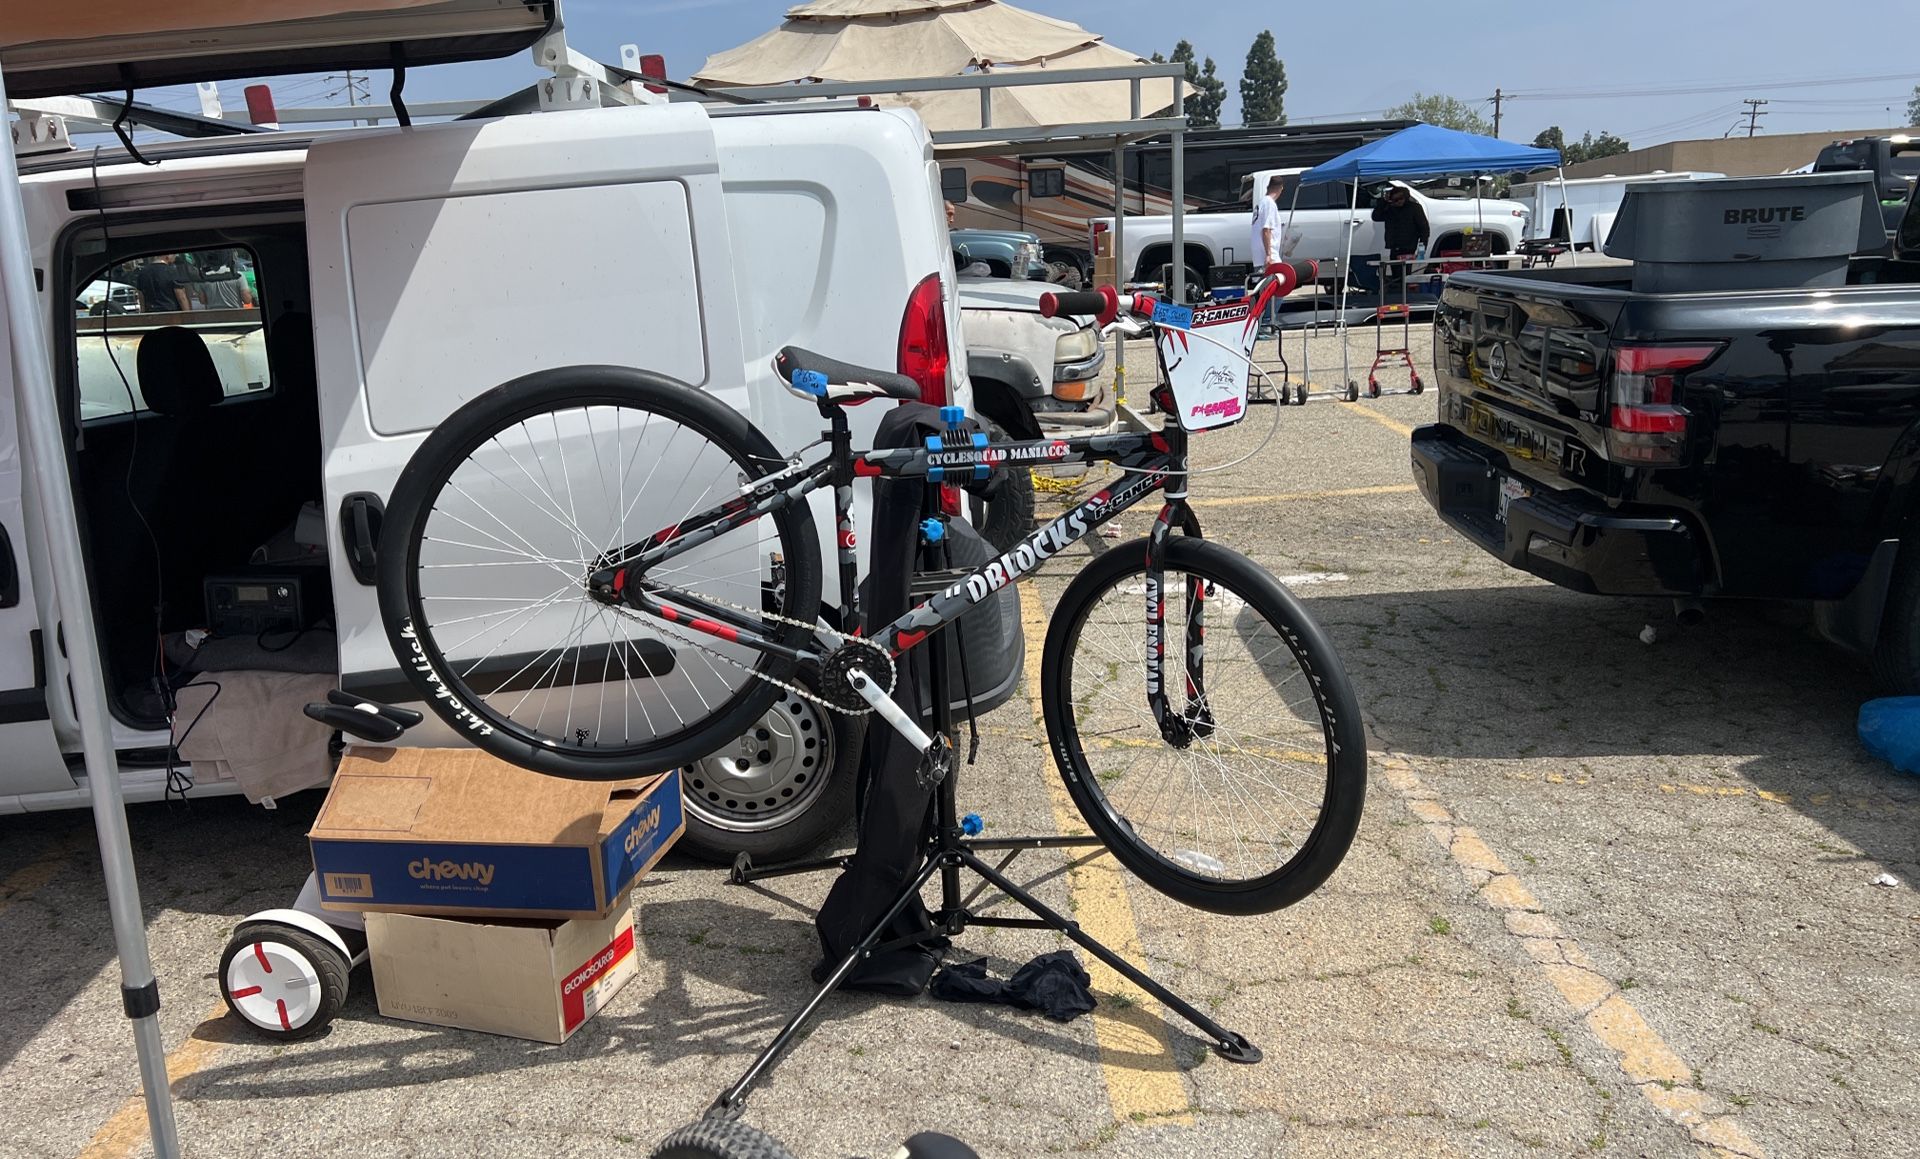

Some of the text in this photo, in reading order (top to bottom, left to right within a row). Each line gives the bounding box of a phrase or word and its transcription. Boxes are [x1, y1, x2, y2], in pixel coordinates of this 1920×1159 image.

[1723, 206, 1806, 224] BRUTE
[1579, 409, 1599, 423] SV
[927, 450, 1007, 466] CYCLESQUAD
[1146, 577, 1159, 694] CYCLESQUAD
[400, 621, 494, 735] thickslick
[624, 804, 660, 854] chewy
[408, 857, 495, 886] chewy
